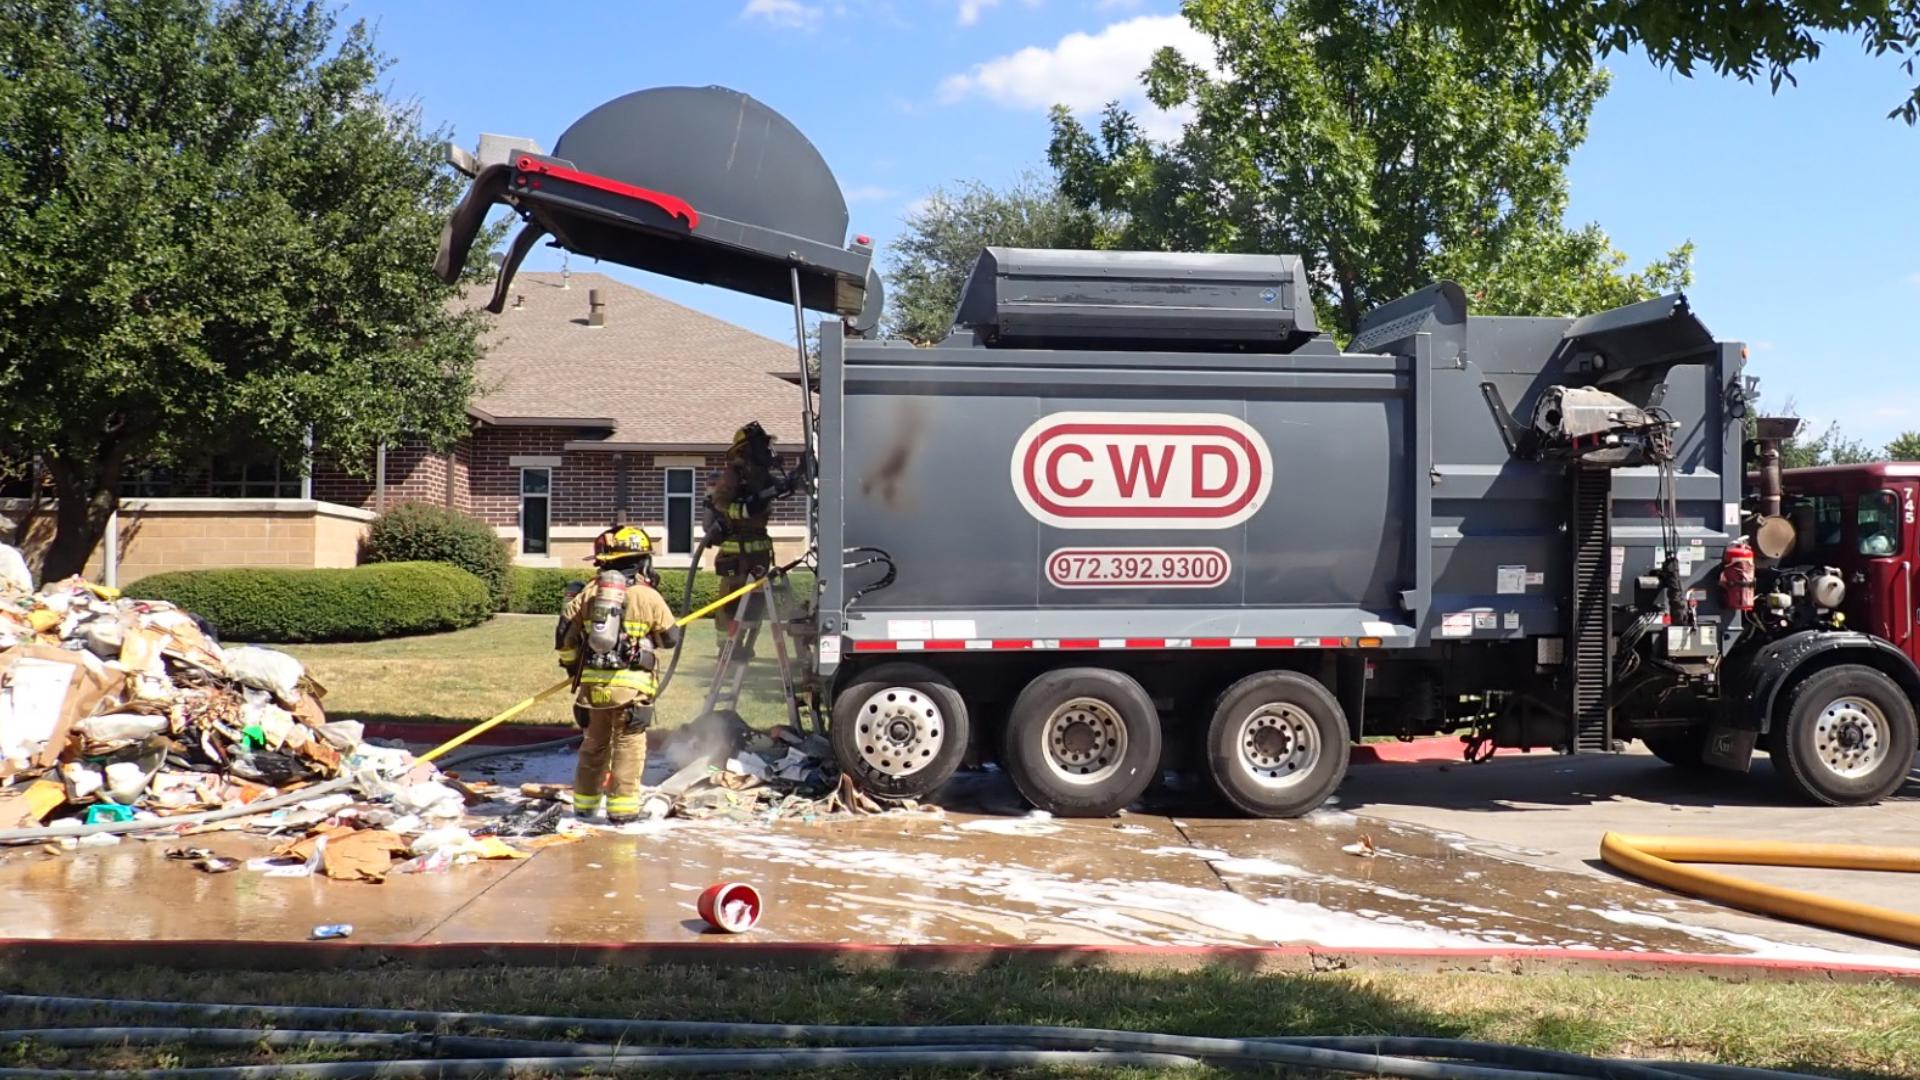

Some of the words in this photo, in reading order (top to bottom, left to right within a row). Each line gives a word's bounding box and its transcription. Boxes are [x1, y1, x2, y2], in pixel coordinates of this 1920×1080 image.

[1045, 443, 1239, 498] CWD
[1903, 487, 1915, 524] 745
[1057, 557, 1219, 579] 972.392.9300
